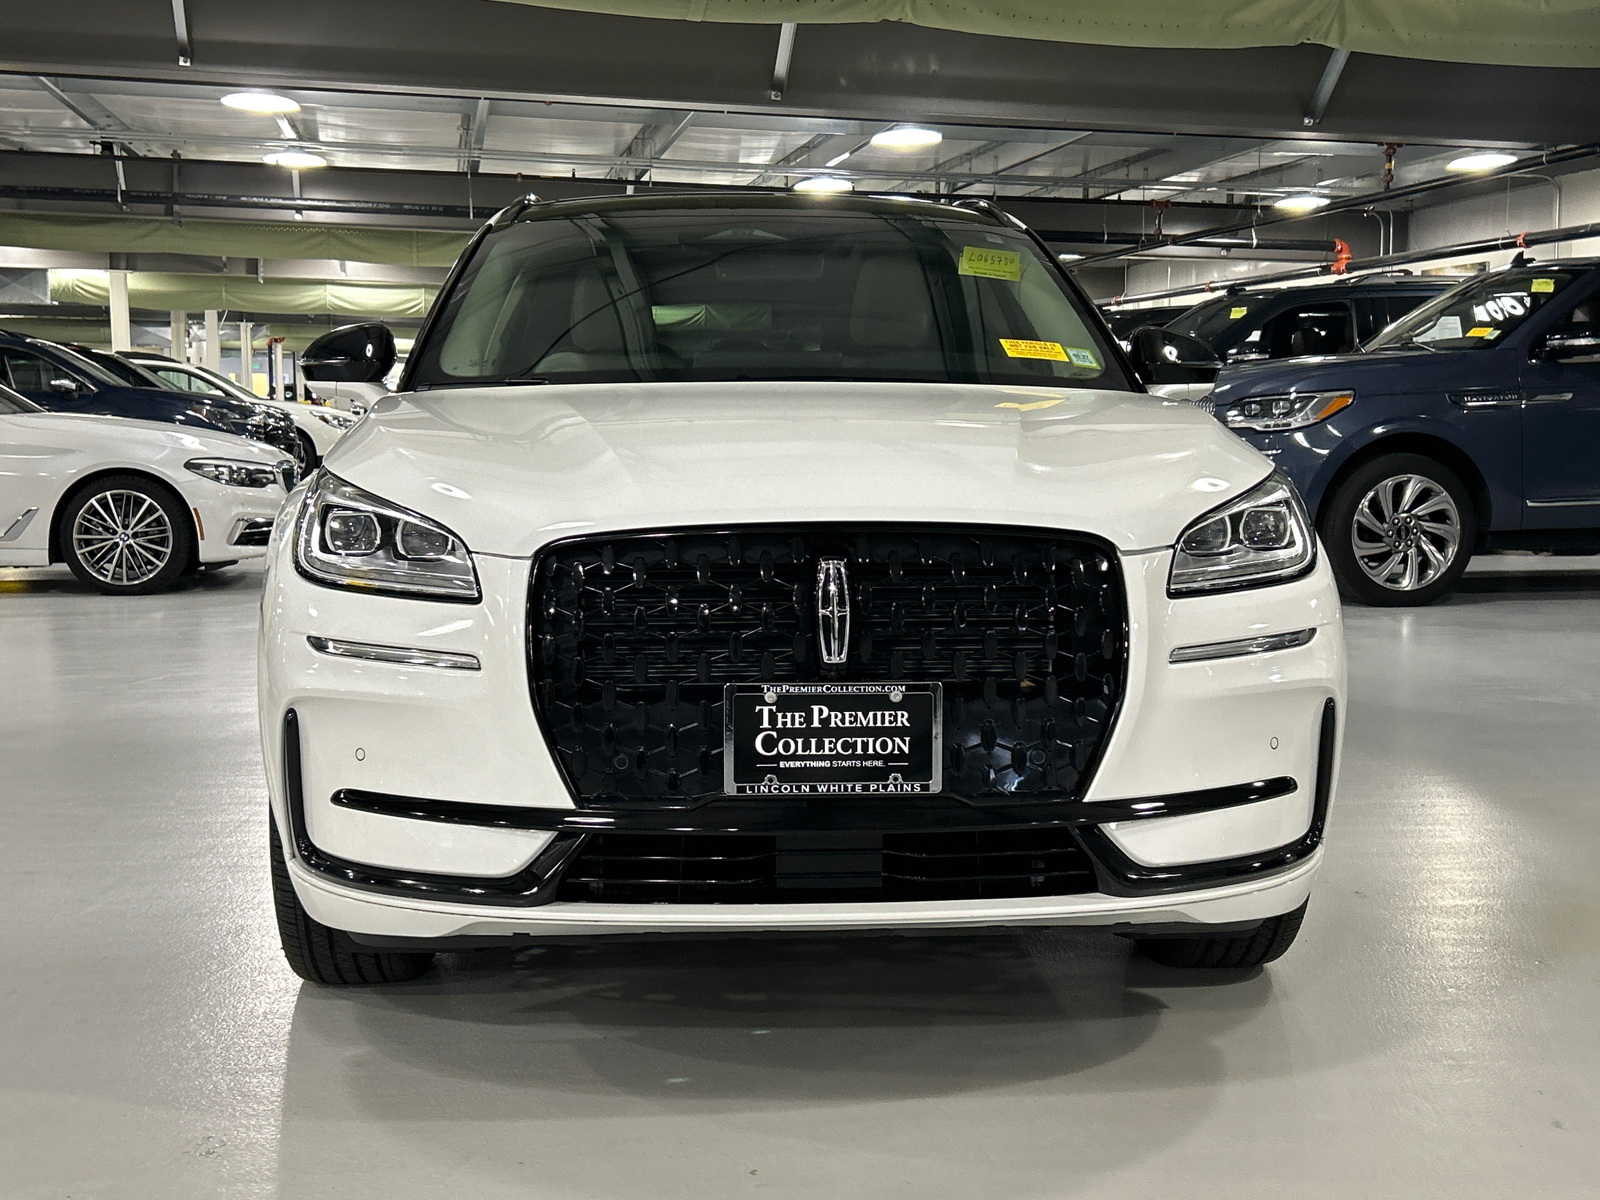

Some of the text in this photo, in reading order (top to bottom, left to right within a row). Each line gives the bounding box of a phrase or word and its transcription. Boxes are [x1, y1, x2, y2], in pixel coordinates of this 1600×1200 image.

[755, 705, 911, 729] THE PREMIER
[755, 731, 911, 756] COLLECTION
[746, 783, 922, 794] LINCOLN WHITE PLAINS
